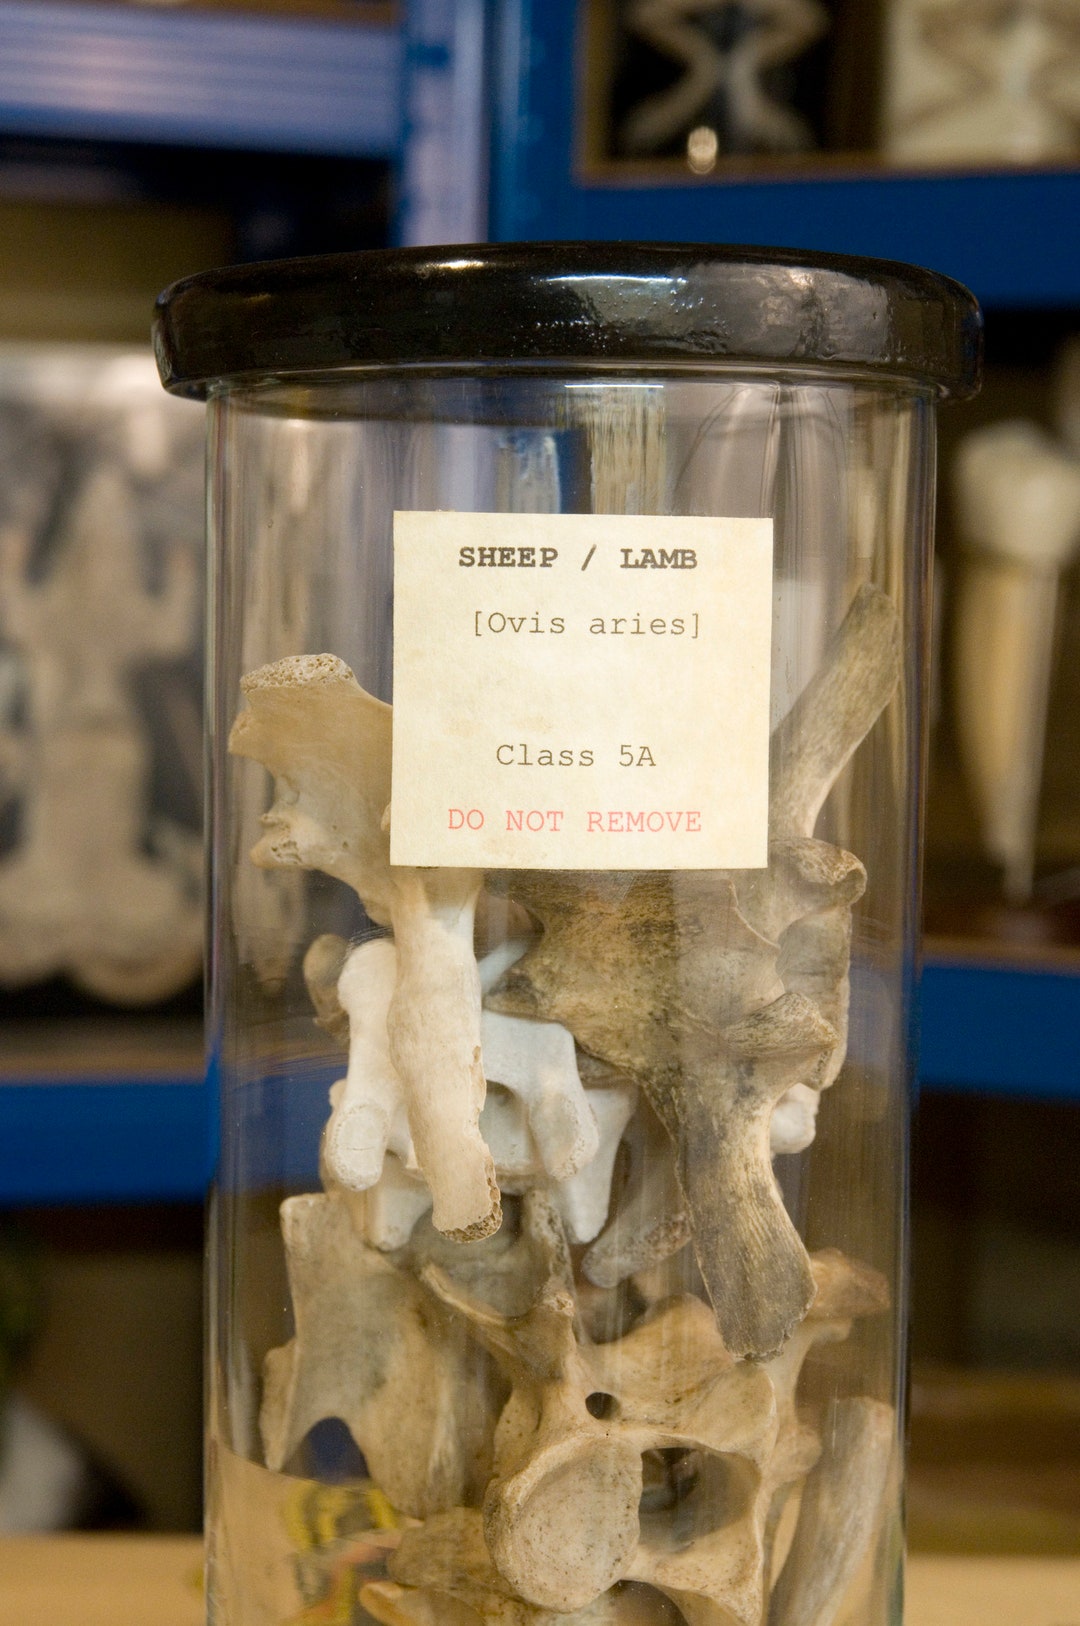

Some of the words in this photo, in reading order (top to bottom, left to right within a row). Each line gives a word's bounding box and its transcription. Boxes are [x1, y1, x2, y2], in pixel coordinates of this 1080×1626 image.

[459, 545, 558, 568] SHEEP
[581, 544, 598, 572] /
[620, 547, 697, 570] LAMB
[475, 610, 566, 637] [Ovis
[589, 611, 699, 639] aries]
[496, 744, 594, 767] Class
[620, 744, 657, 767] 5A
[448, 809, 485, 831] DO
[506, 810, 563, 832] NOT
[588, 811, 702, 832] REMOVE
